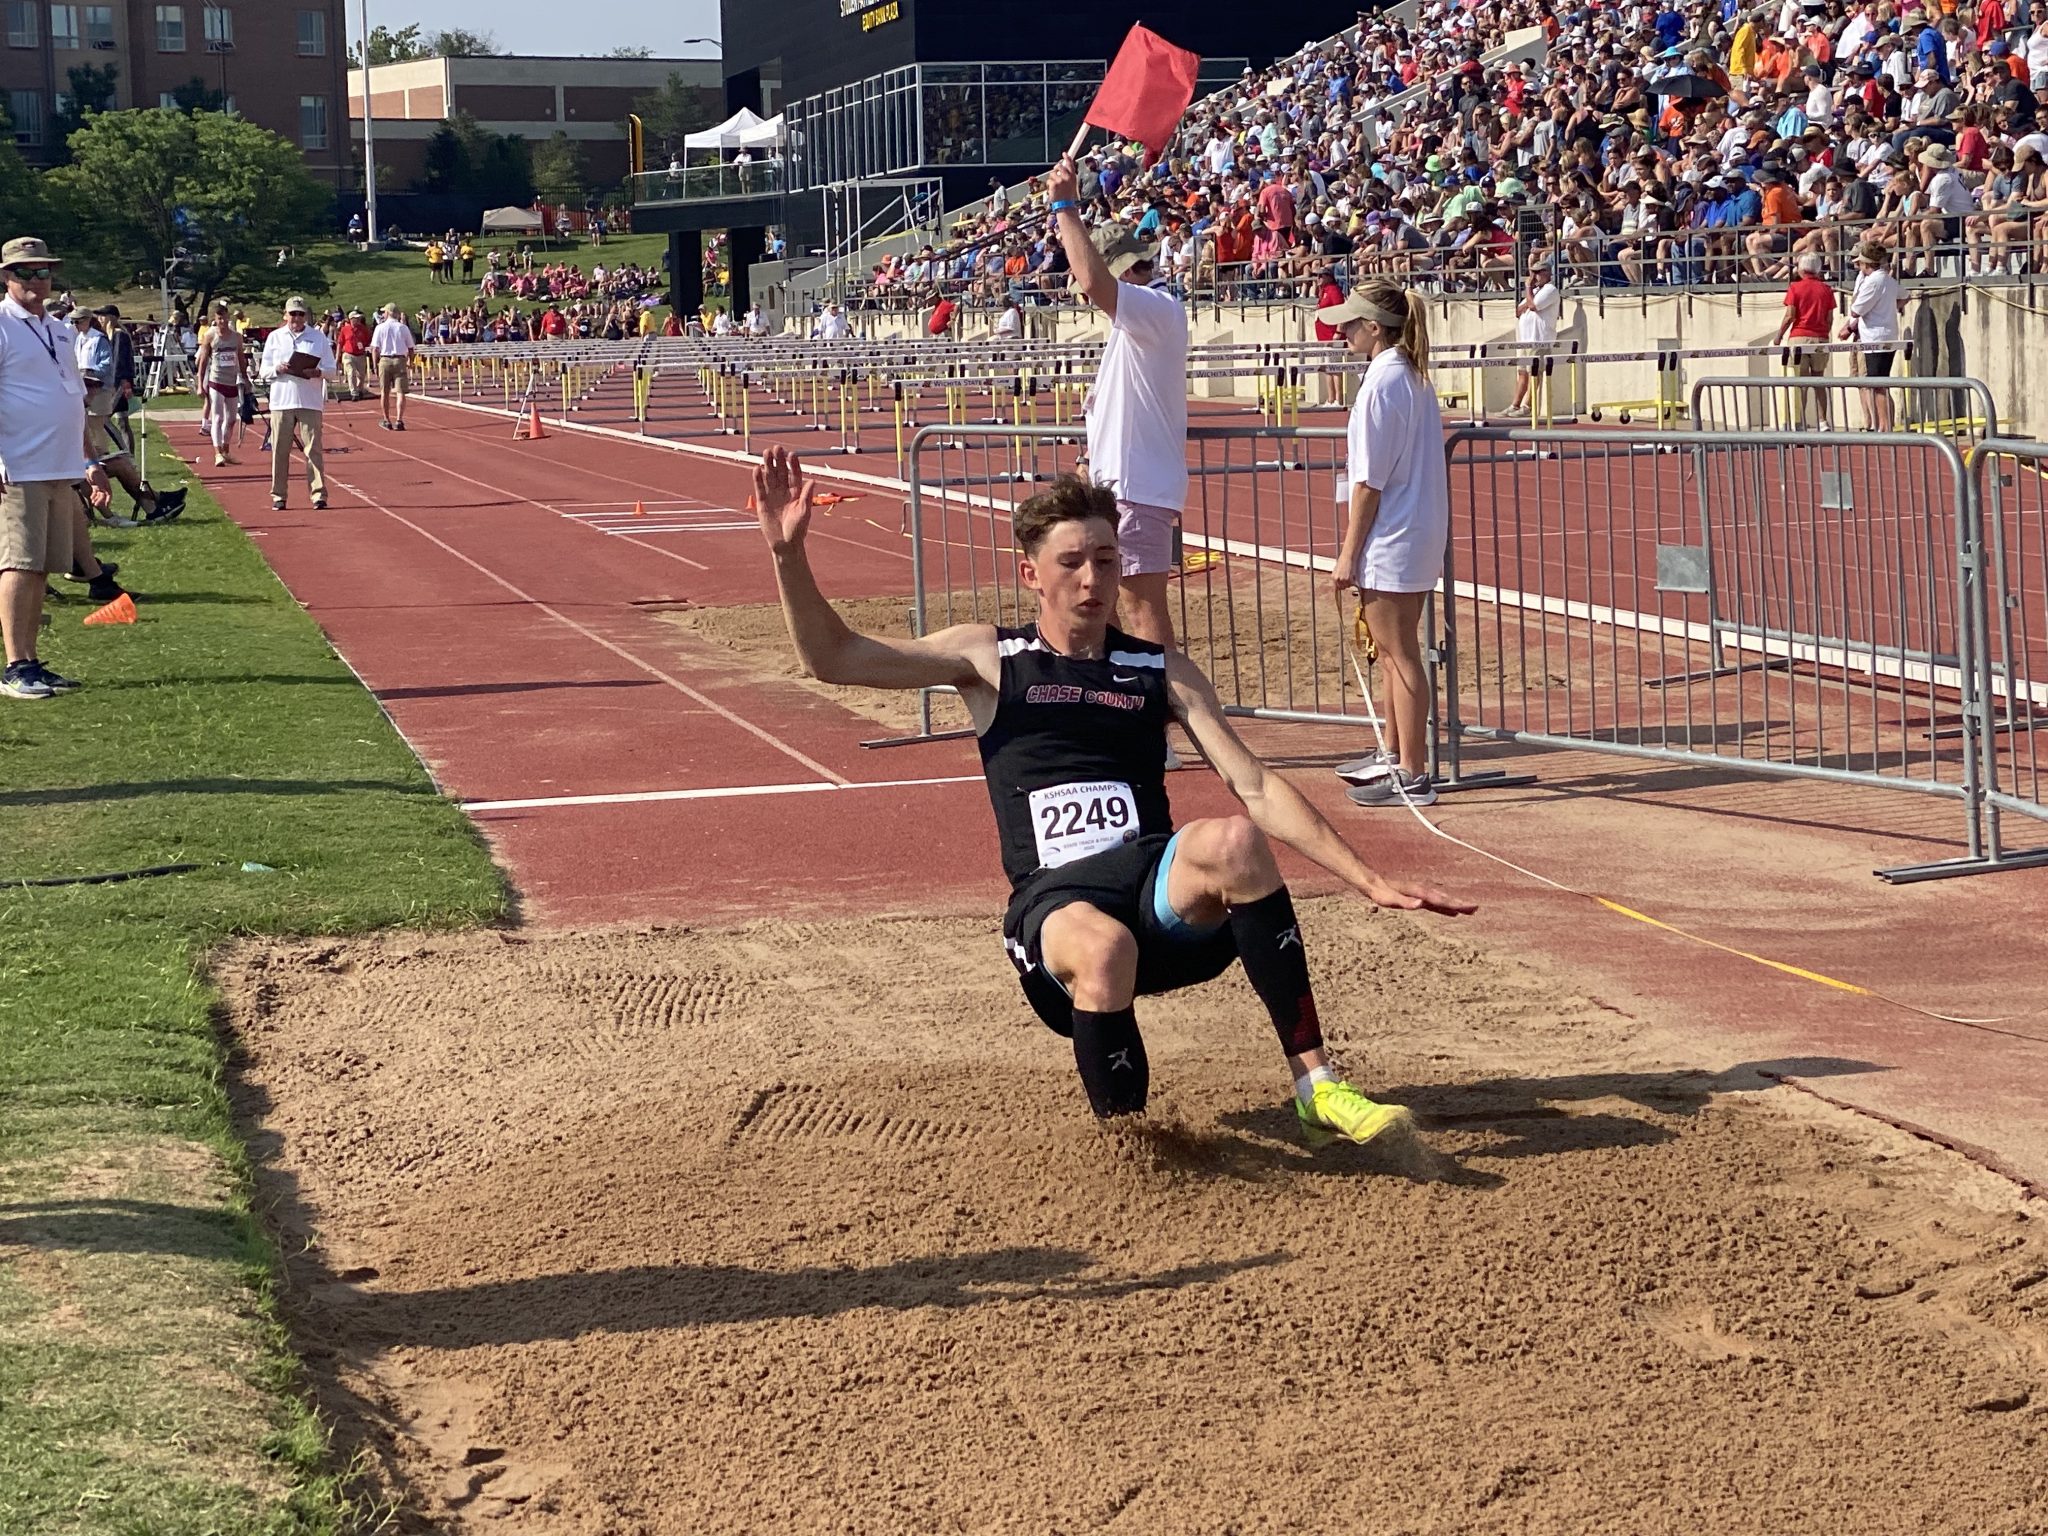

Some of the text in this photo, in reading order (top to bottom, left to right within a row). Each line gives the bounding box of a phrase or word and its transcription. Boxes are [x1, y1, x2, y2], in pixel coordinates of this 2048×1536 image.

[1735, 348, 1756, 356] STATE
[1580, 355, 1610, 363] WICHITA
[1196, 370, 1228, 378] WICHITA
[1026, 685, 1144, 710] CHASE COUNTY
[1044, 784, 1118, 800] KSHSAA CHAMPS
[1041, 797, 1128, 840] 2249
